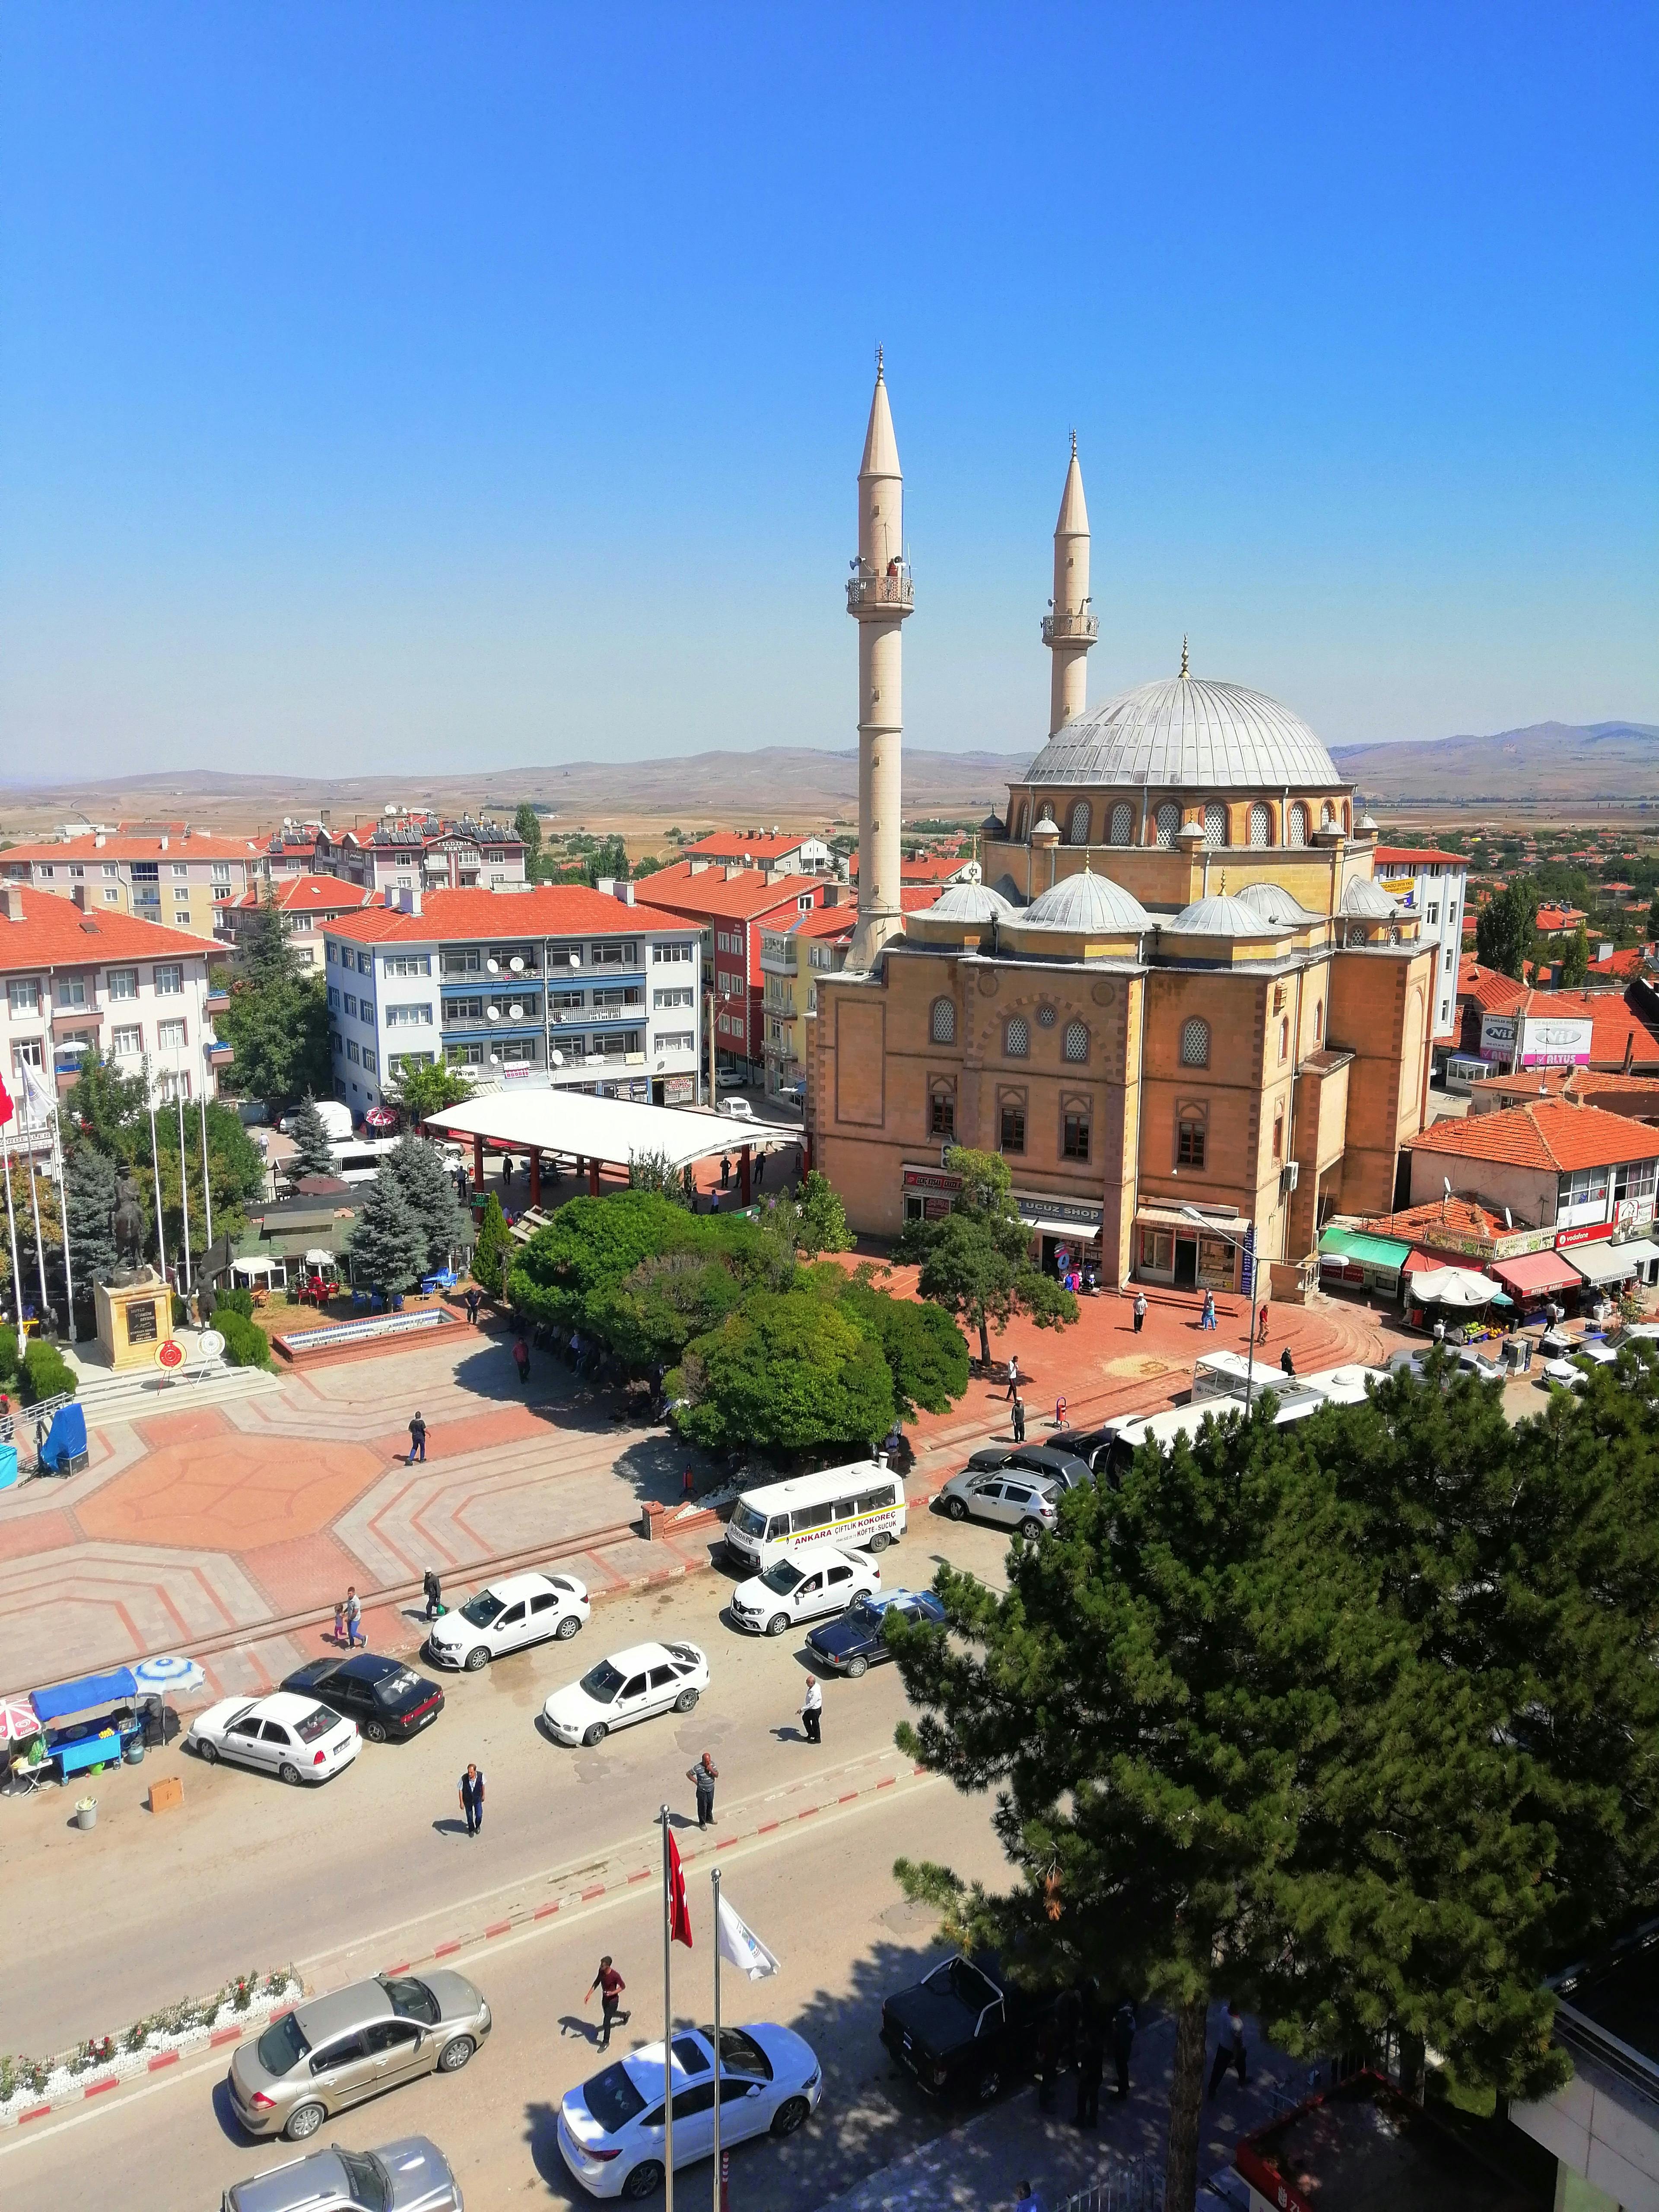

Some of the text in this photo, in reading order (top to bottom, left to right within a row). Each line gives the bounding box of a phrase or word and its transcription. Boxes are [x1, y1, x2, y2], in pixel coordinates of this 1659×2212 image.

[1547, 1055, 1576, 1063] ALTUS
[917, 1177, 928, 1185] GENÇ
[928, 1178, 941, 1187] KUŞAK
[1026, 1202, 1060, 1212] UCUZ
[1064, 1208, 1099, 1220] SHOP
[1567, 1233, 1589, 1242] vodafone
[795, 1511, 896, 1545] ANKARA ÇİFTLİK KOKOREÇ
